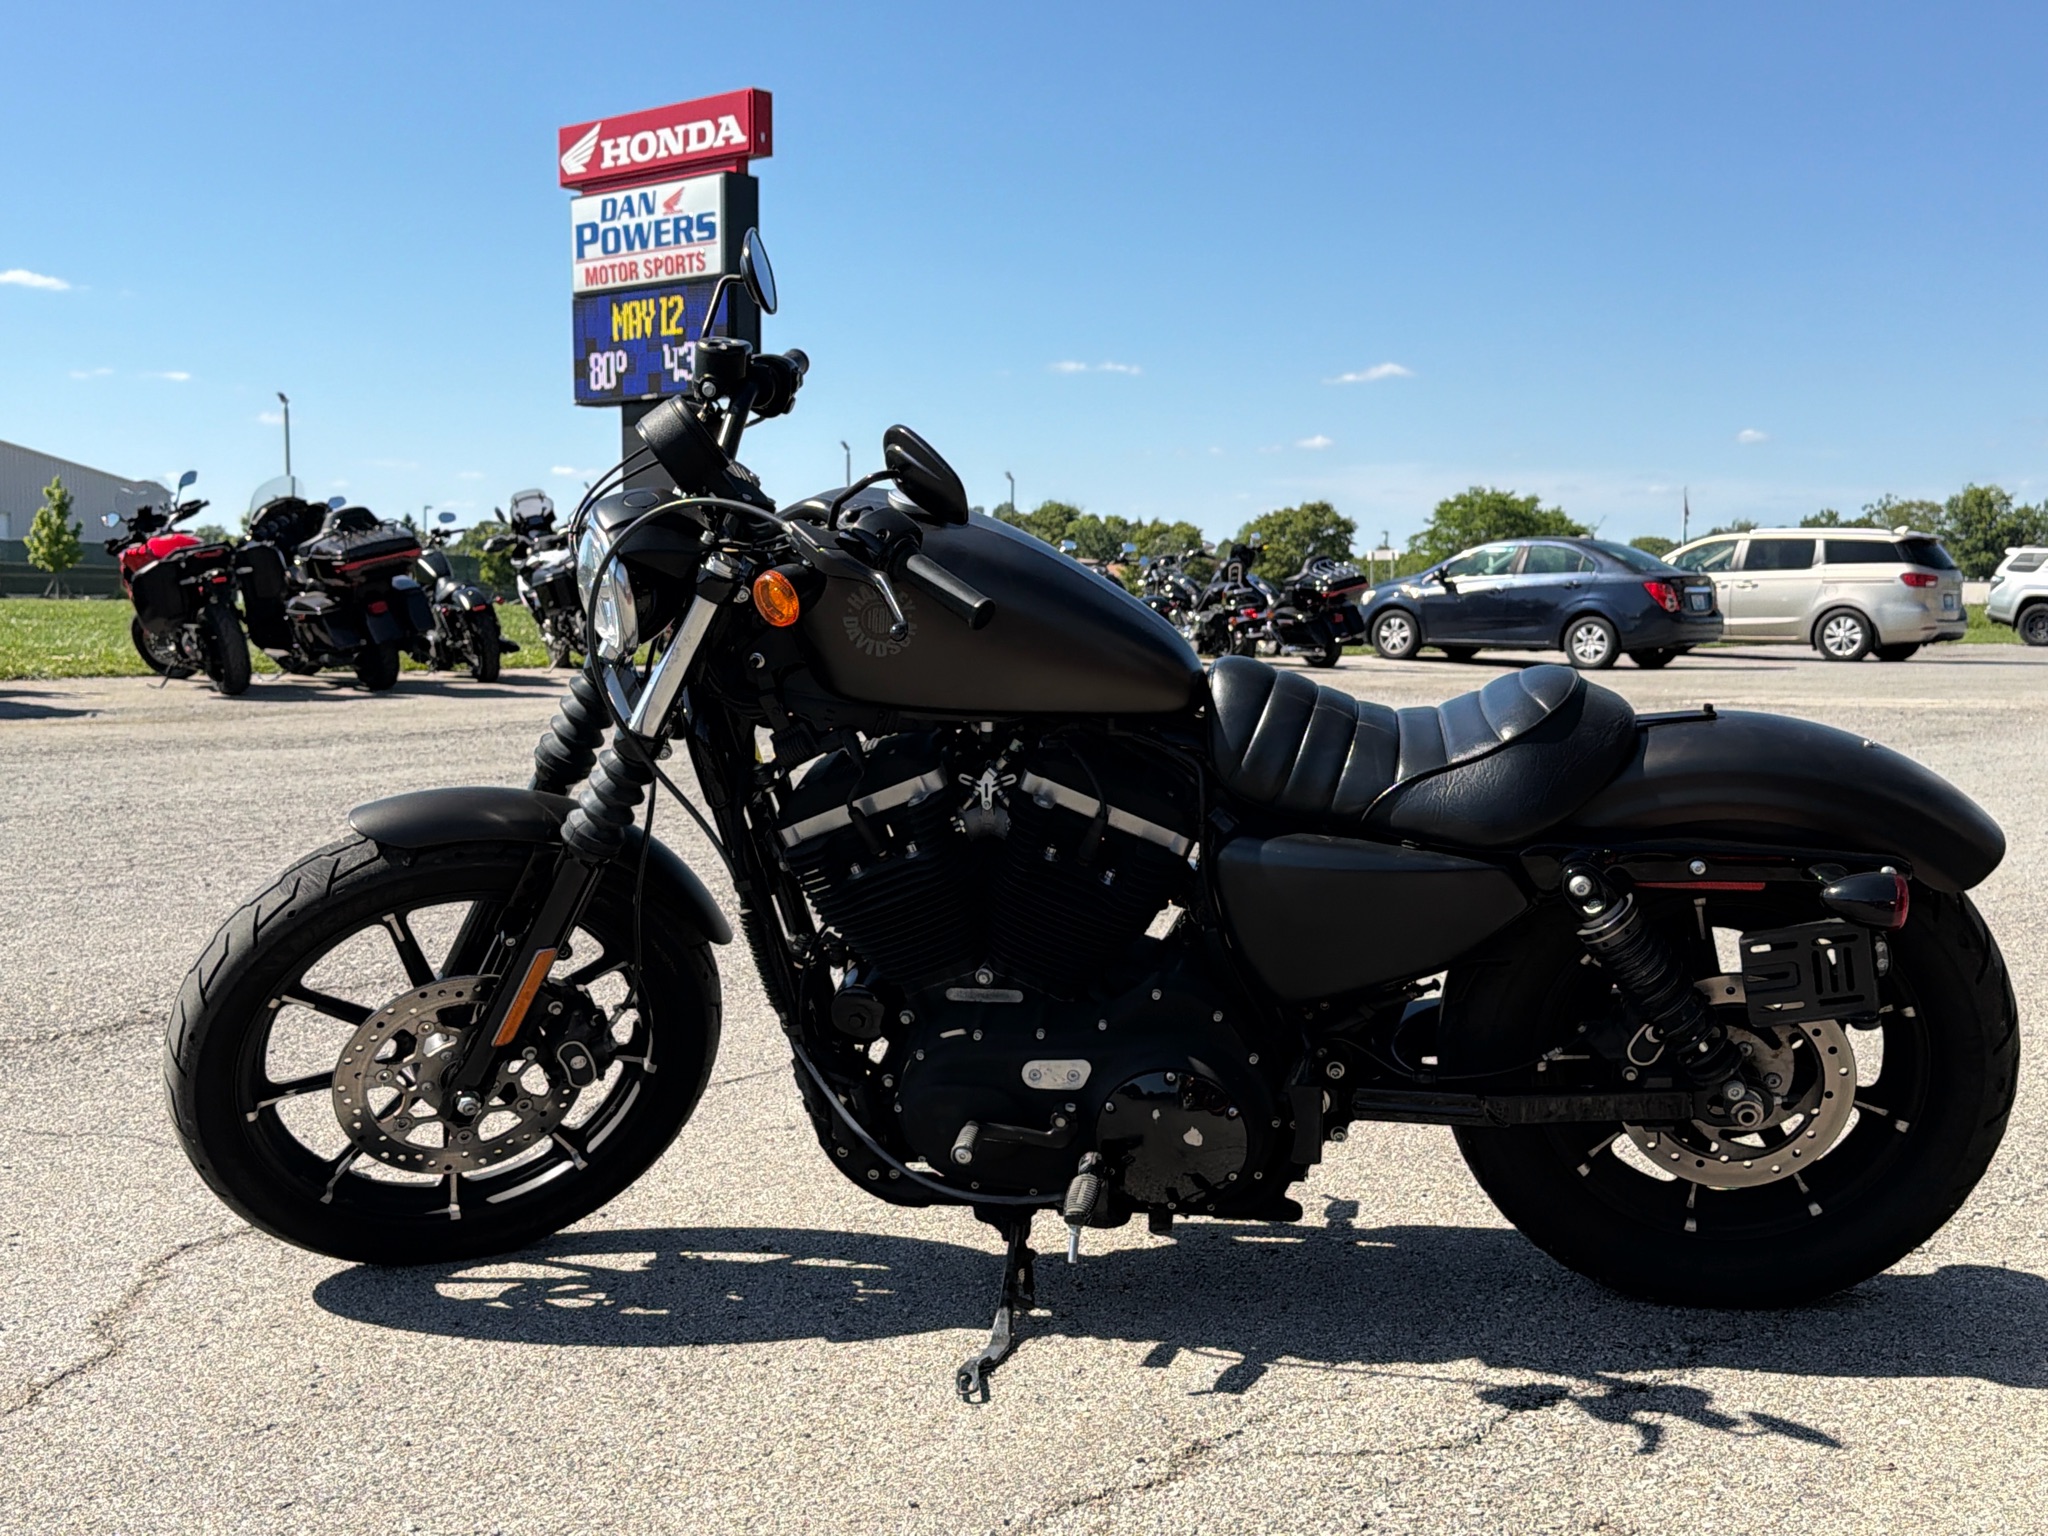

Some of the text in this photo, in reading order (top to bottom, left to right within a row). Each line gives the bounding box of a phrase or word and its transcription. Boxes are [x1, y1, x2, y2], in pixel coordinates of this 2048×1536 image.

[600, 114, 747, 169] HONDA
[601, 190, 657, 223] DAN
[576, 212, 716, 259] POWERS
[585, 251, 706, 287] MOTOR SPORTS
[612, 295, 685, 342] MAY 12
